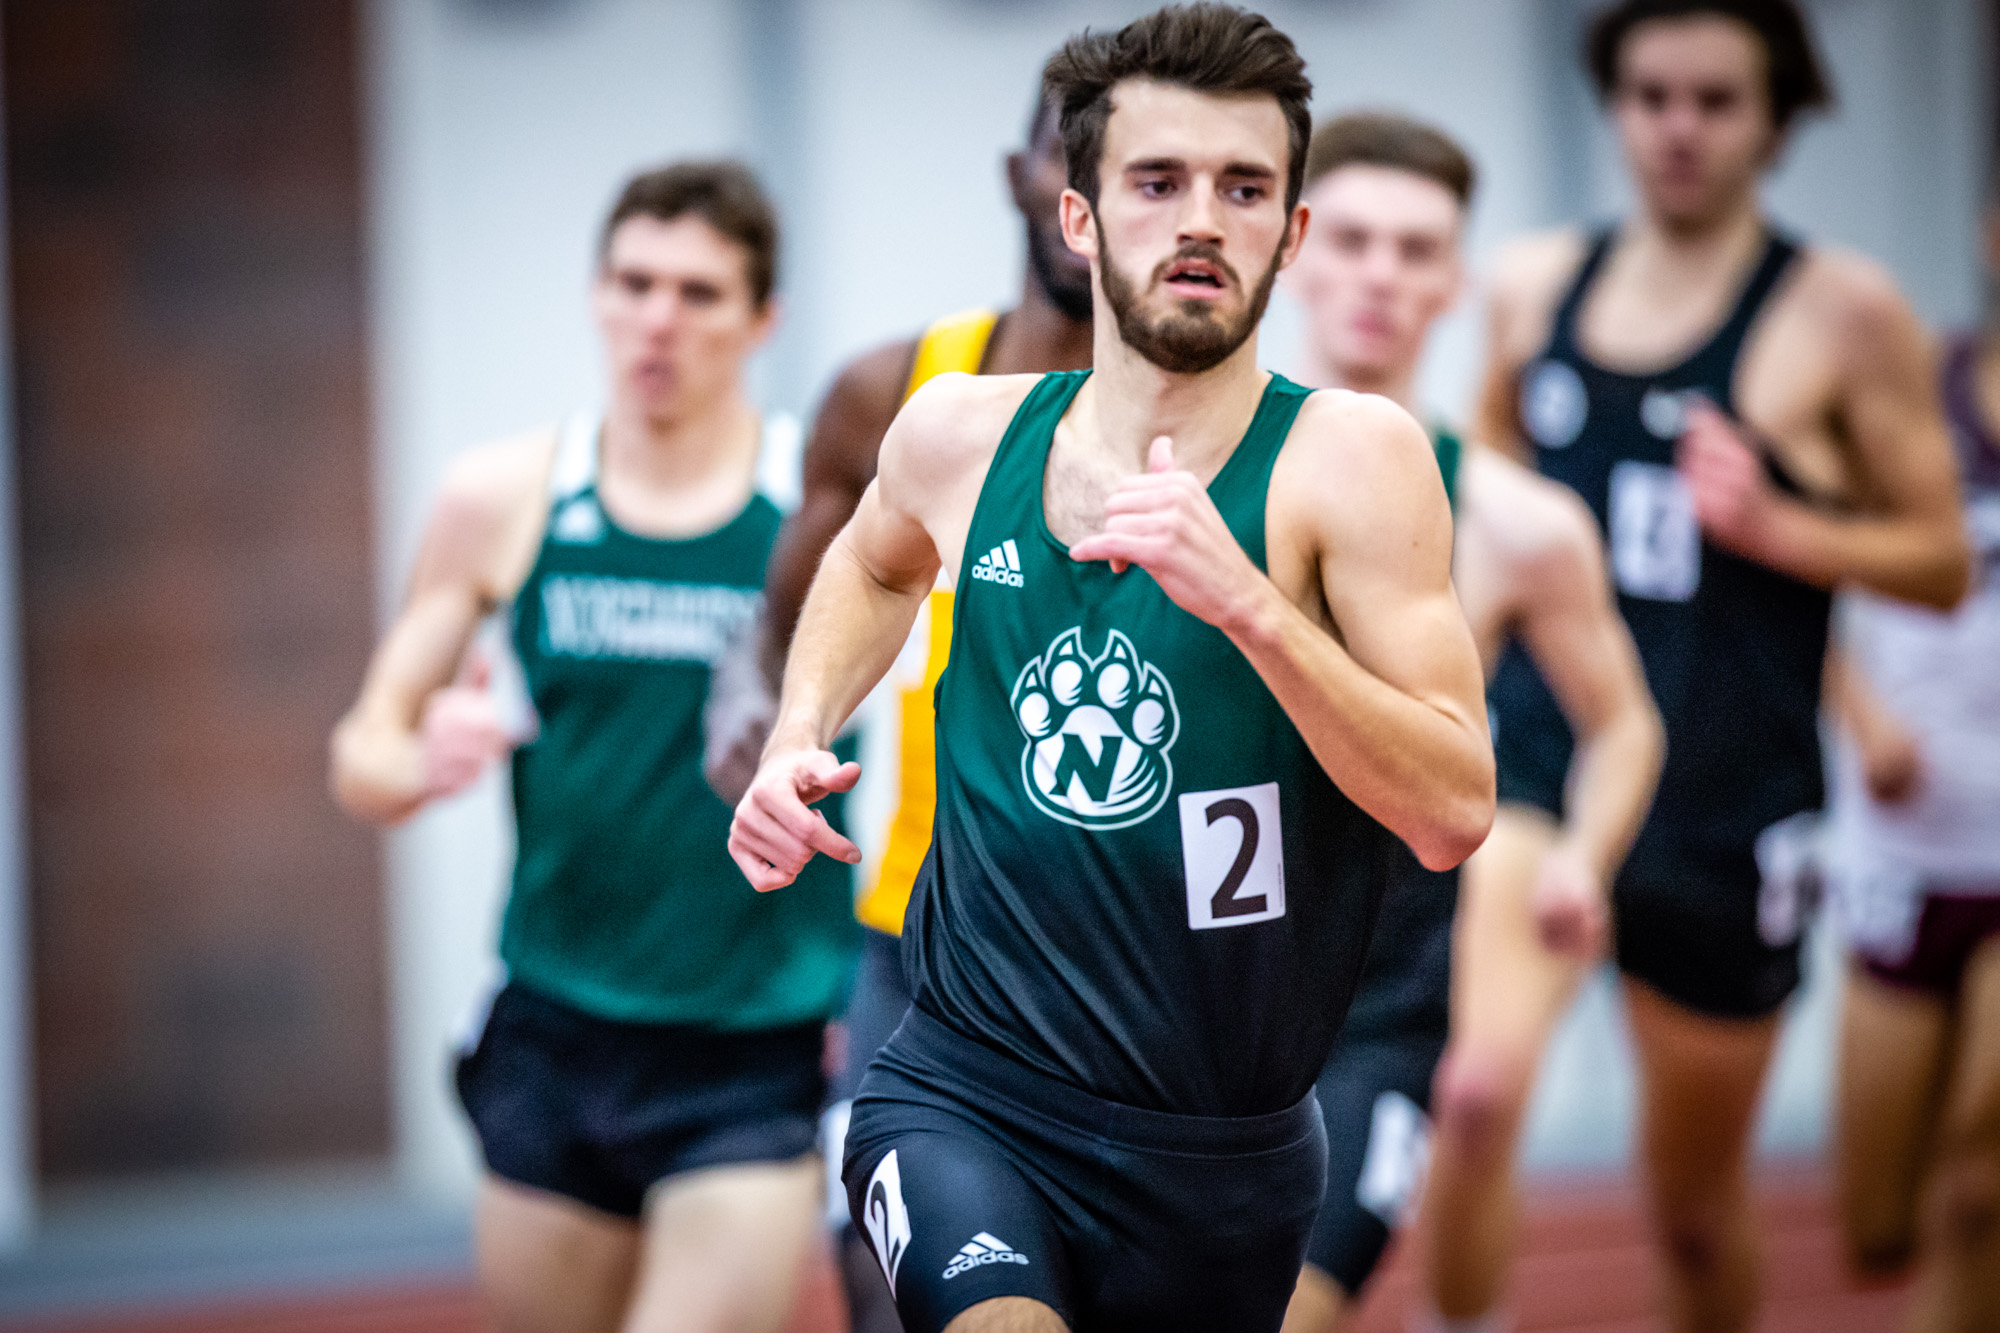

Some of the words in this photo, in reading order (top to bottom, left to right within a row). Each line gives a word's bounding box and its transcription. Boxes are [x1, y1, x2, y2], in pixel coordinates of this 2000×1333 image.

[971, 564, 1025, 588] adidas
[1048, 732, 1124, 802] N
[1205, 797, 1268, 919] 2
[870, 1180, 902, 1283] 2
[942, 1250, 1030, 1280] adidas
